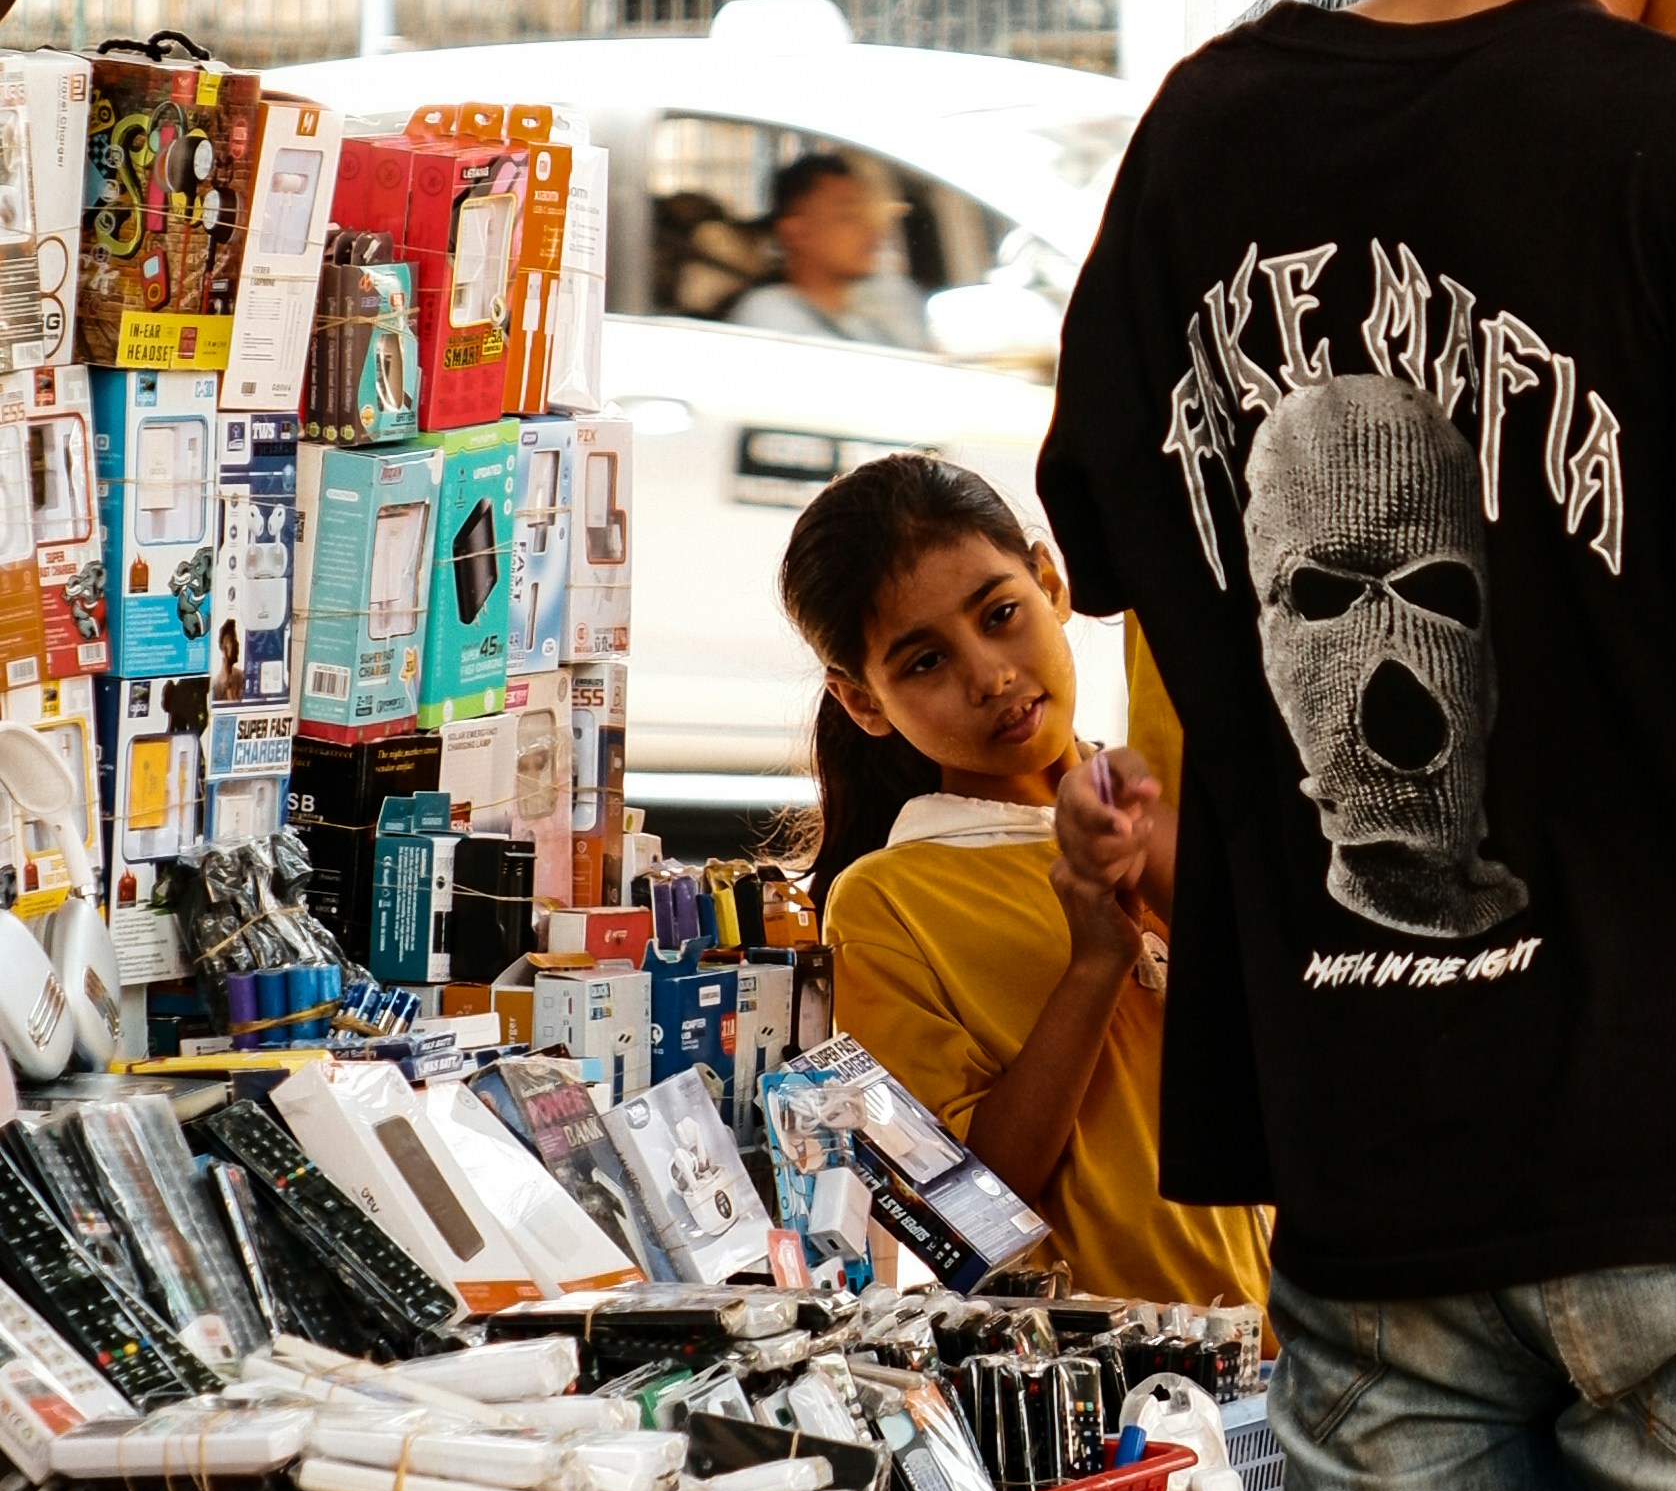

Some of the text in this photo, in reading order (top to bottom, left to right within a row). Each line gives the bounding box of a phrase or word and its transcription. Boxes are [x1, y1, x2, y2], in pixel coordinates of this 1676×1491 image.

[56, 114, 68, 169] Charger
[129, 322, 161, 340] IN-EAR
[127, 344, 176, 362] HEADSET
[443, 343, 481, 369] SMART
[1162, 237, 1625, 592] FAKE MAFIA
[514, 540, 527, 603] FAST
[237, 716, 293, 739] SUPER FAST
[234, 739, 290, 766] CHARGER
[1303, 950, 1378, 990] MAFIA
[1373, 950, 1413, 988] IN
[1408, 955, 1467, 988] THE
[807, 1045, 839, 1069] SUPER
[562, 1116, 604, 1148] BANK
